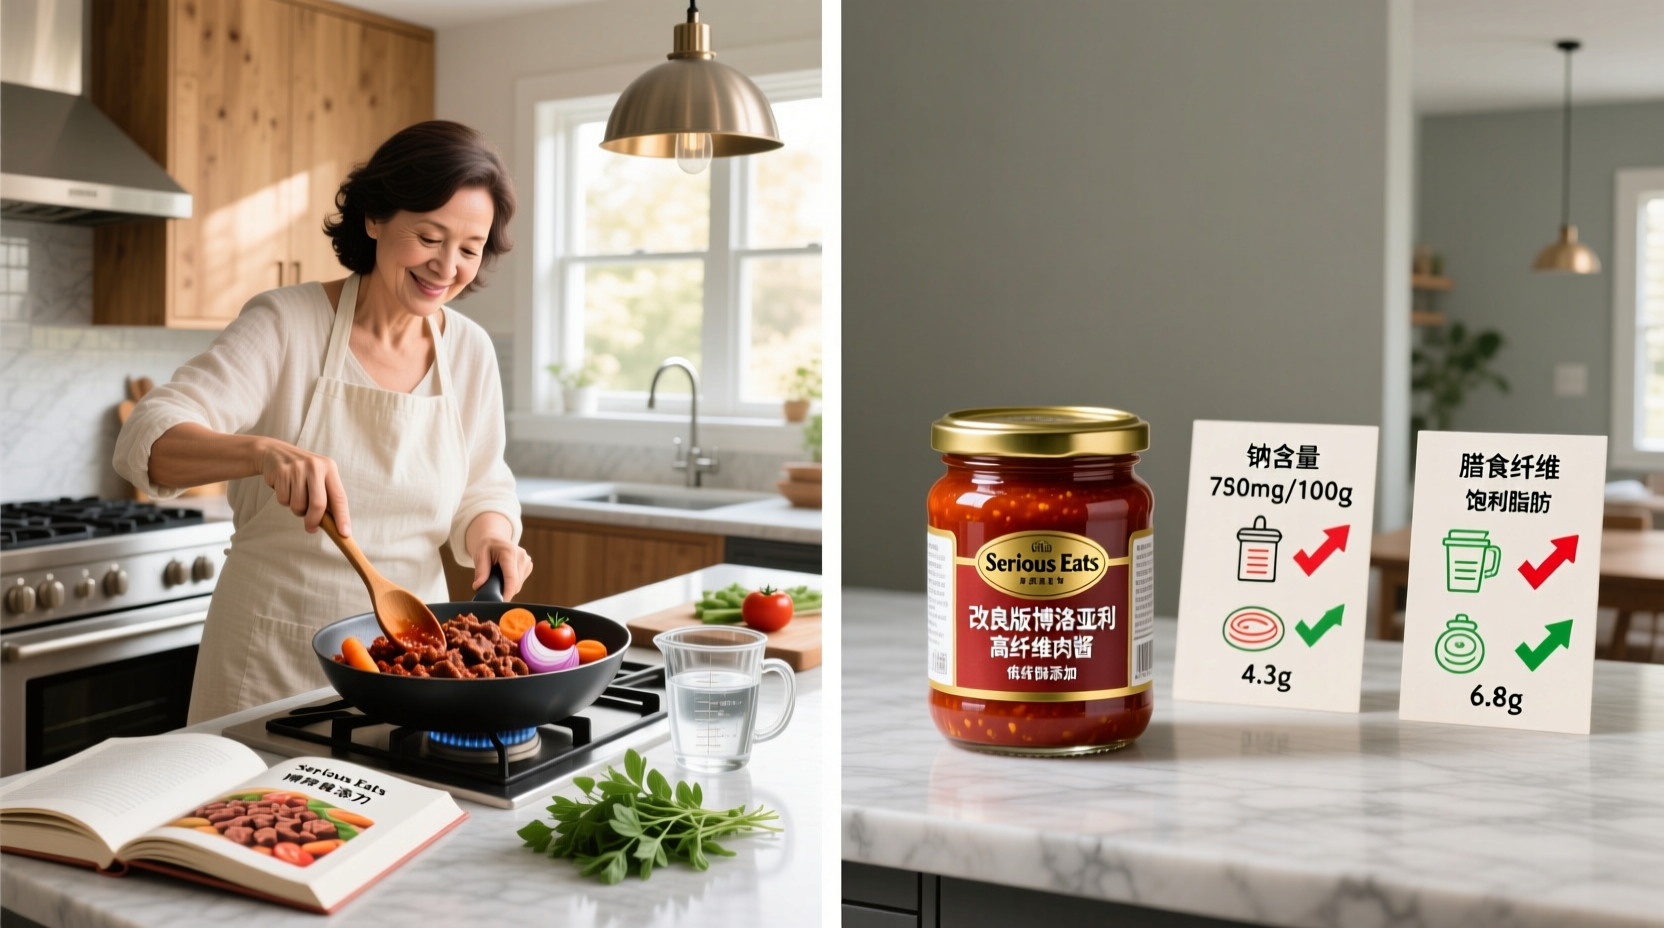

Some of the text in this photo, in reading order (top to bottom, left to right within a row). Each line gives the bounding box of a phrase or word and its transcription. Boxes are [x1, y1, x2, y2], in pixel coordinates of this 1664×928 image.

[1247, 443, 1320, 470] 钠含量
[985, 552, 1099, 573] Serious Eats
[969, 605, 1116, 632] 改良版博洛亚利
[1241, 664, 1292, 693] 4.3g
[1470, 684, 1524, 715] 6.8g
